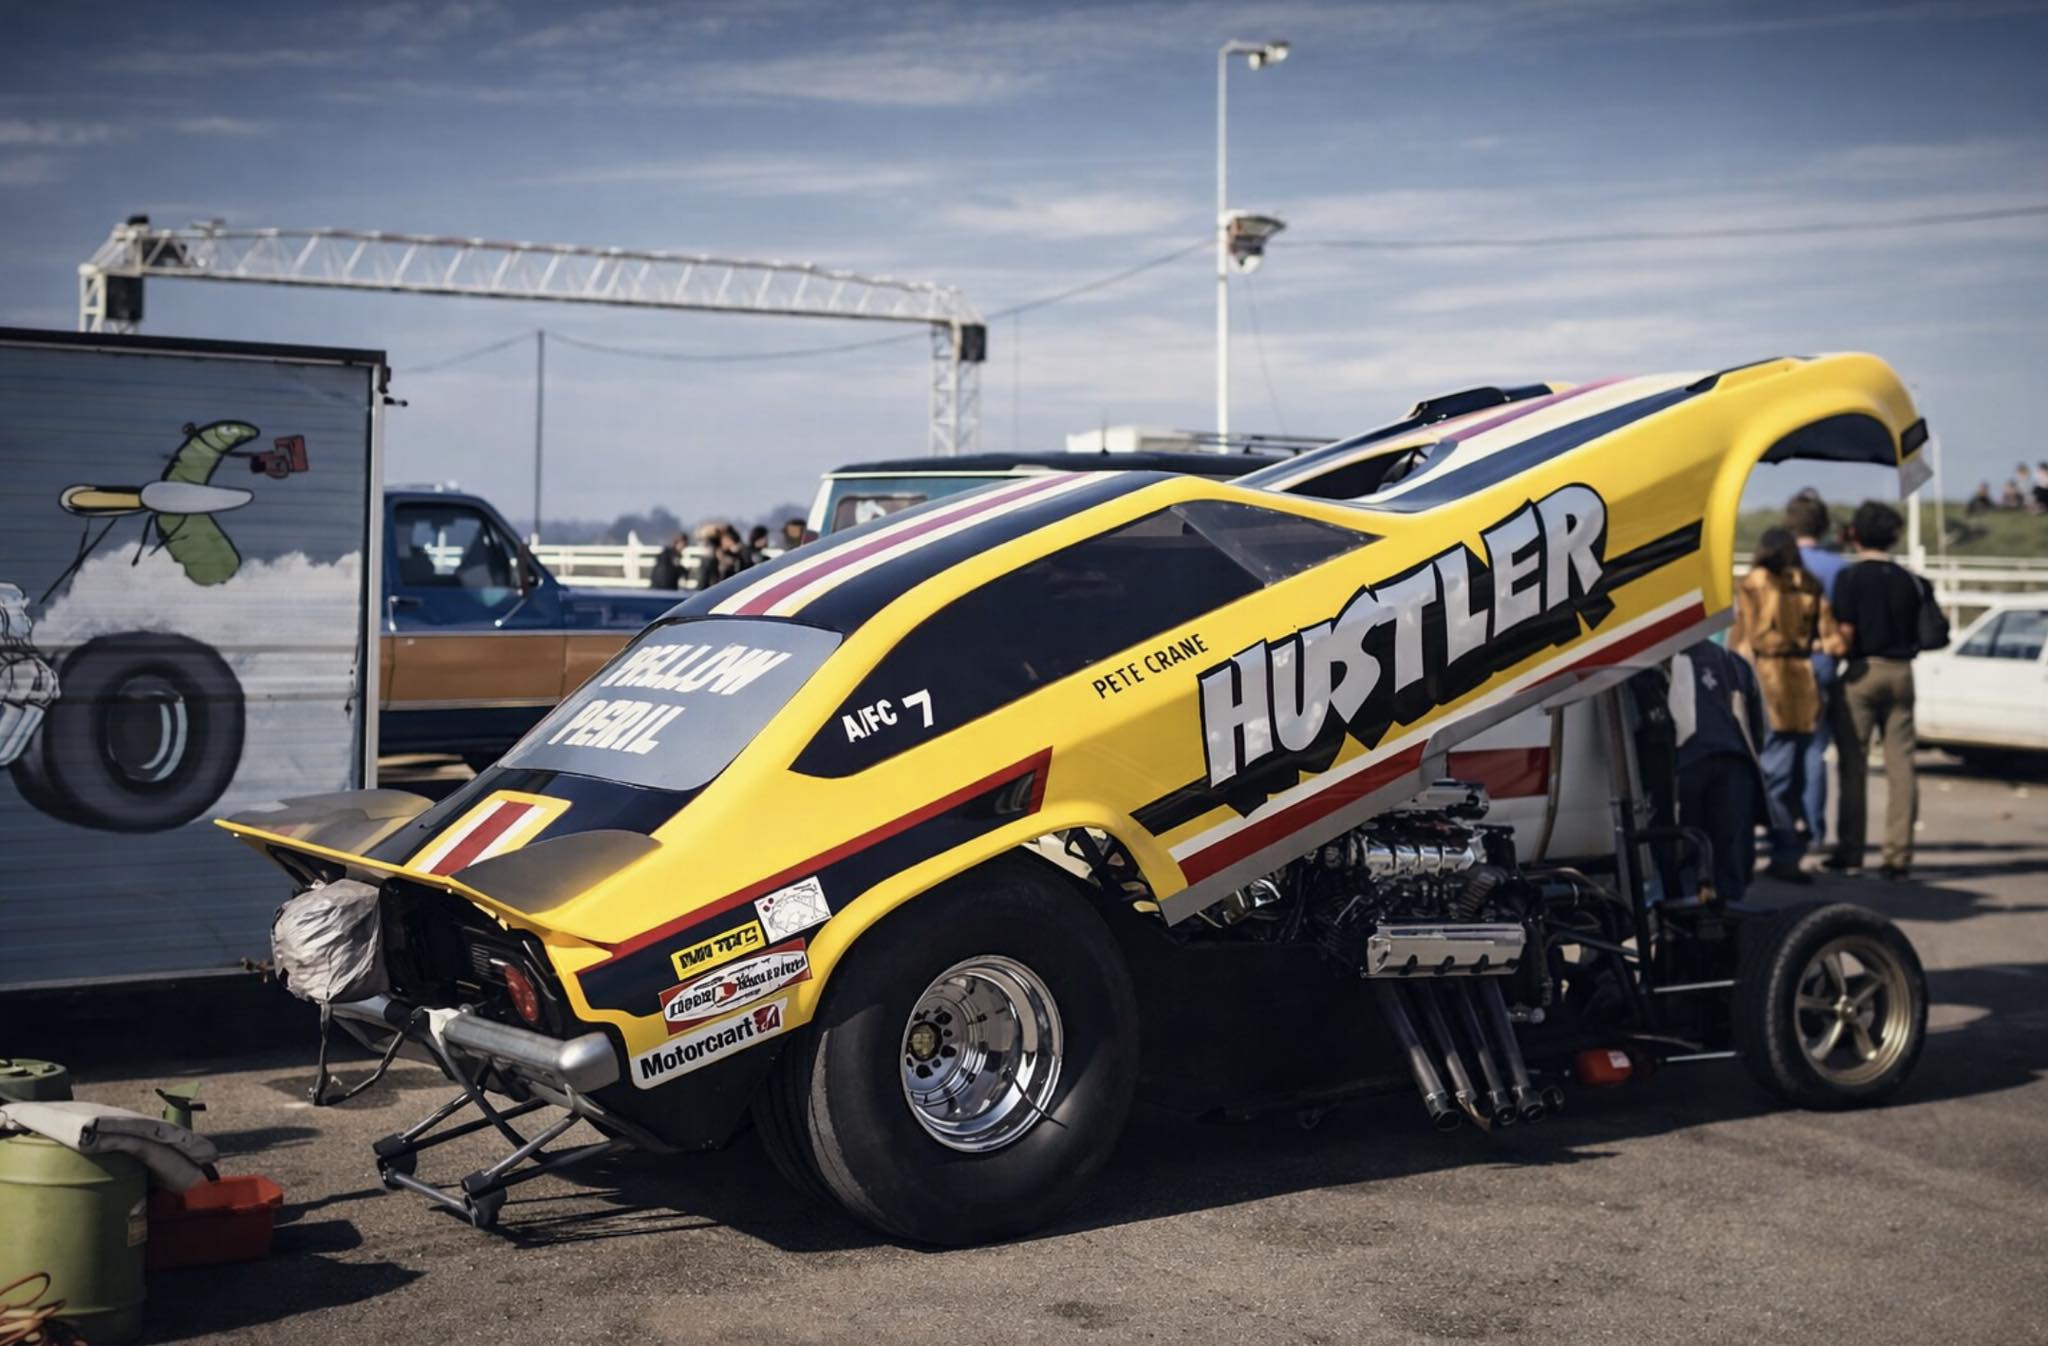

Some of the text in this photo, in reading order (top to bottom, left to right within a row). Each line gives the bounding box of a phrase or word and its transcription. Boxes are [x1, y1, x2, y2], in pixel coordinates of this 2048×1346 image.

[1092, 633, 1209, 700] PETE CRANE
[1197, 482, 1608, 792] HUSTLER
[547, 699, 685, 755] PERIL
[842, 688, 934, 743] A/FC 7
